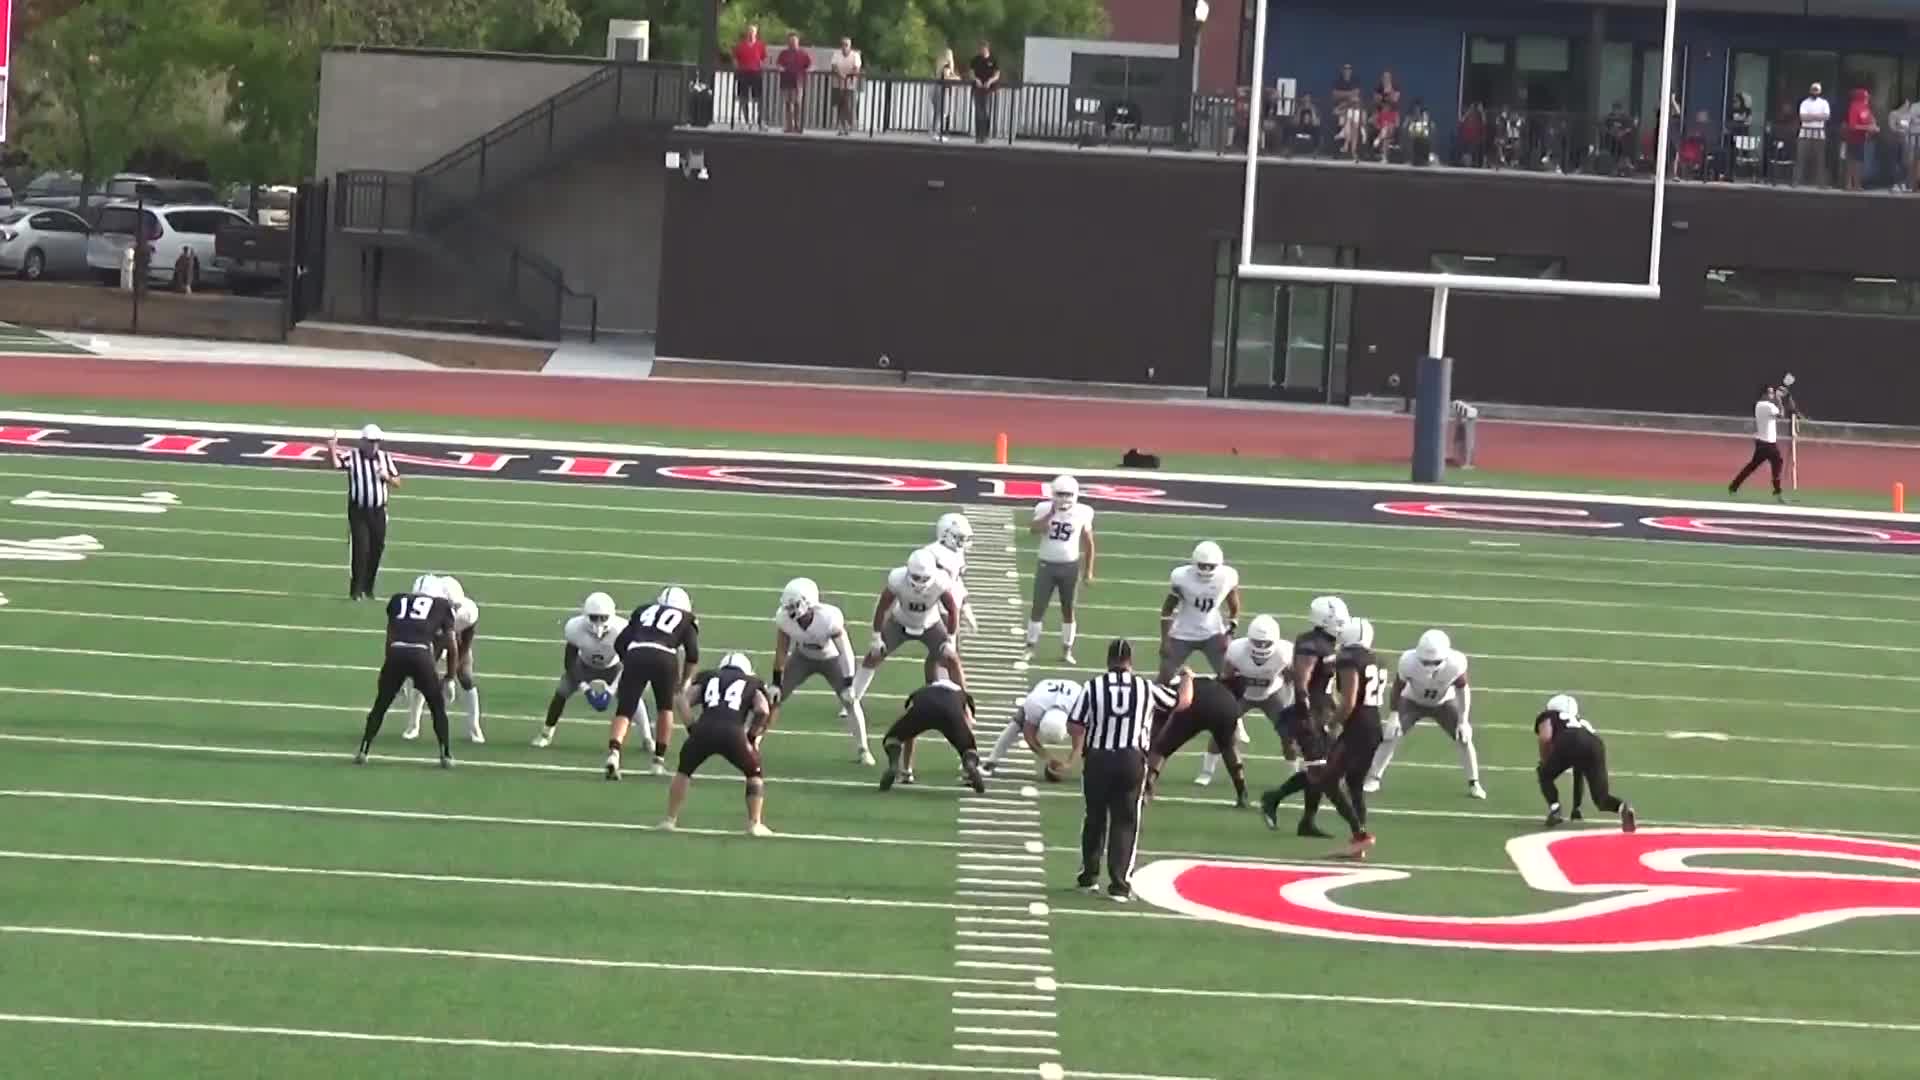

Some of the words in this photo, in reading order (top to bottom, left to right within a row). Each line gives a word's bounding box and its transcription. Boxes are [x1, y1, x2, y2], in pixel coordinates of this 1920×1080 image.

[1049, 521, 1073, 541] 35
[396, 597, 434, 620] 19
[640, 604, 682, 633] 40
[704, 677, 747, 711] 44
[1109, 685, 1131, 715] U
